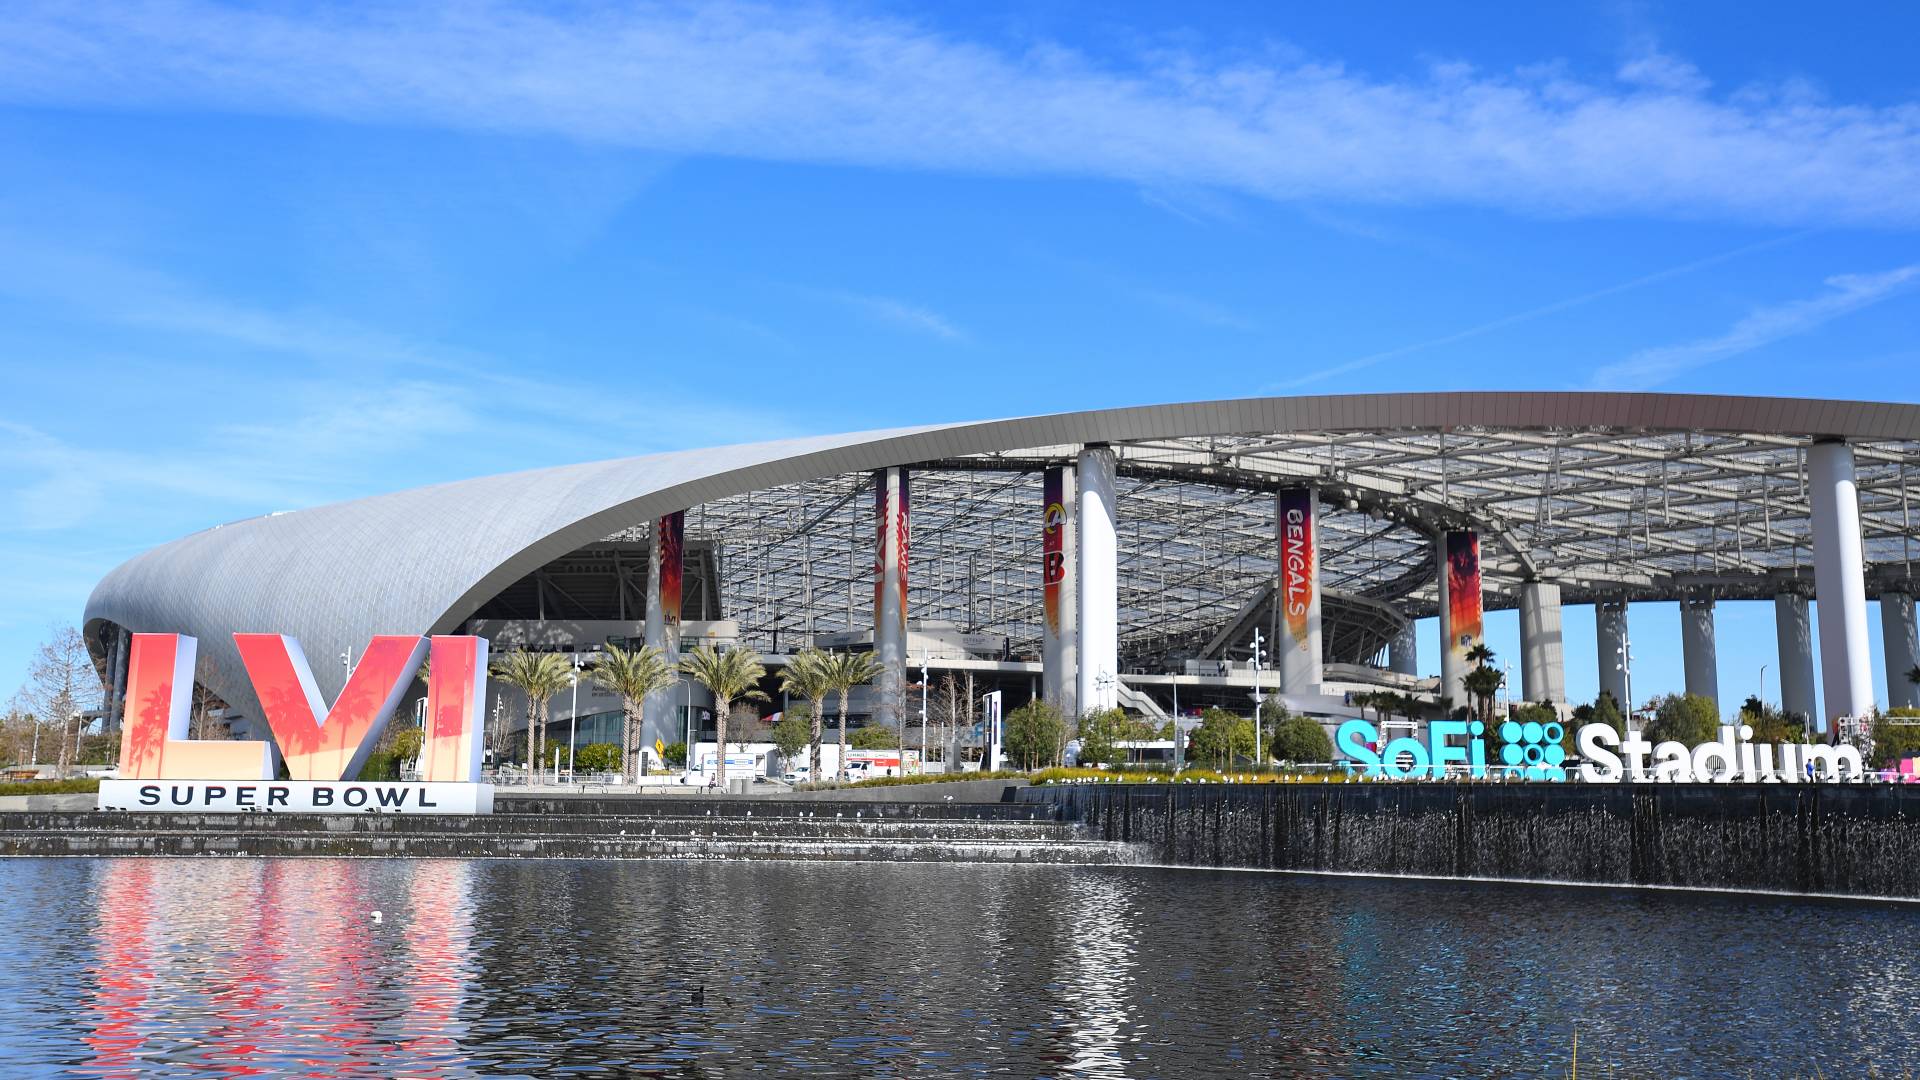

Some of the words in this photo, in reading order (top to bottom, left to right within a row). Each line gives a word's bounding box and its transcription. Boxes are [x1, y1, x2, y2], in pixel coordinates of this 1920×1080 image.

[1287, 509, 1305, 616] BENGALS
[118, 632, 490, 783] LVI
[1335, 719, 1488, 780] SoFi
[1575, 723, 1863, 783] Stadium
[138, 785, 291, 807] SUPER
[311, 786, 438, 808] BOWL
